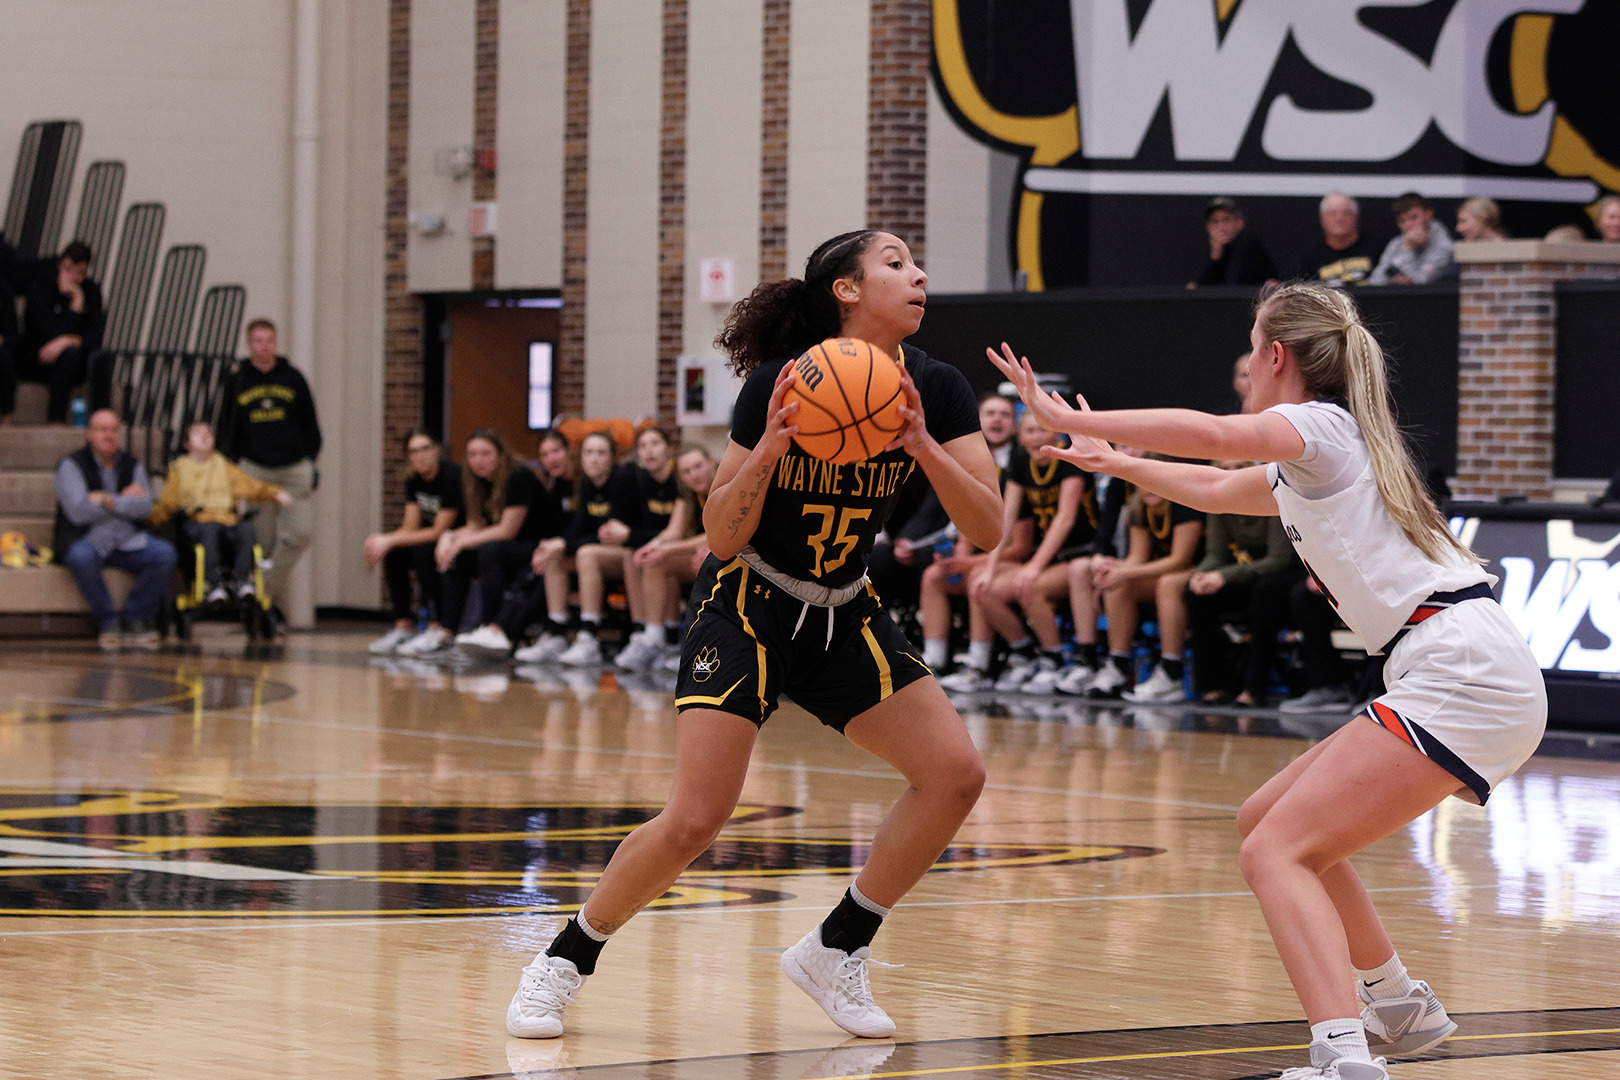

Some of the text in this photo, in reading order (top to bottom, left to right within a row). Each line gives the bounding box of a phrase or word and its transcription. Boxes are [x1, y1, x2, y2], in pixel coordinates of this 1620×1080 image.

[1070, 0, 1585, 167] WSC
[778, 454, 905, 498] WAYNE STATE
[801, 503, 873, 578] 35
[695, 662, 713, 671] WSC
